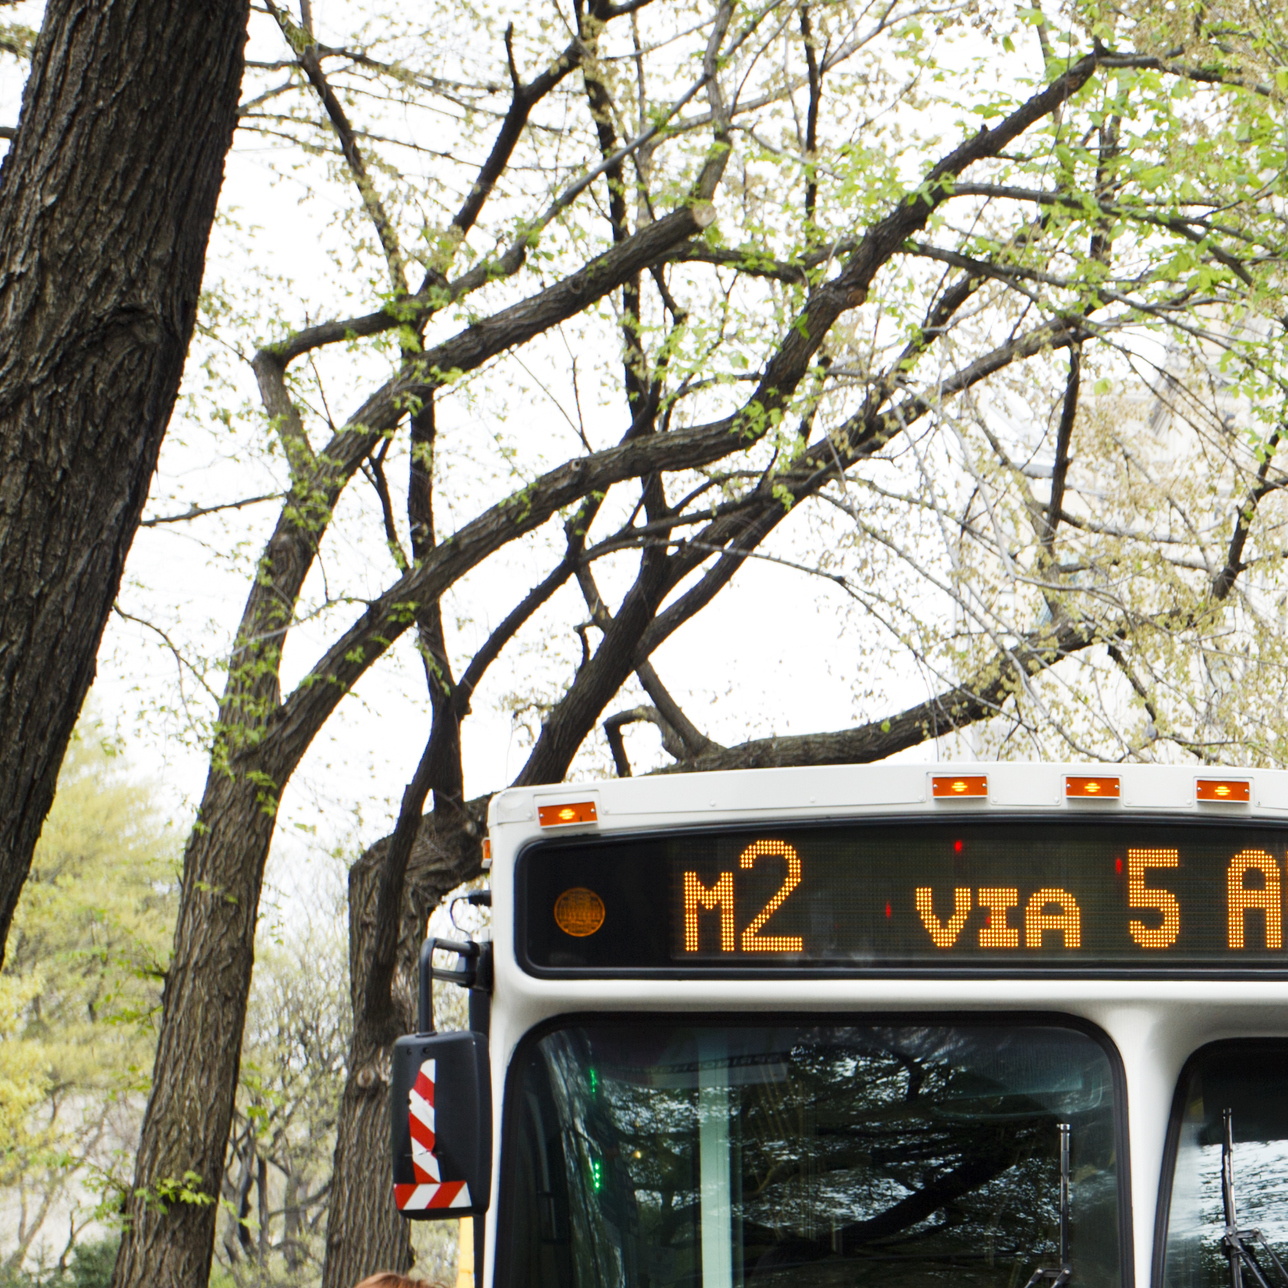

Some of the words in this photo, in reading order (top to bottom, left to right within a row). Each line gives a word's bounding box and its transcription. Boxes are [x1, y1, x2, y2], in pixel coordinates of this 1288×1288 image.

[683, 838, 803, 953] M2
[915, 884, 1083, 949] VIA
[1126, 846, 1181, 949] 5
